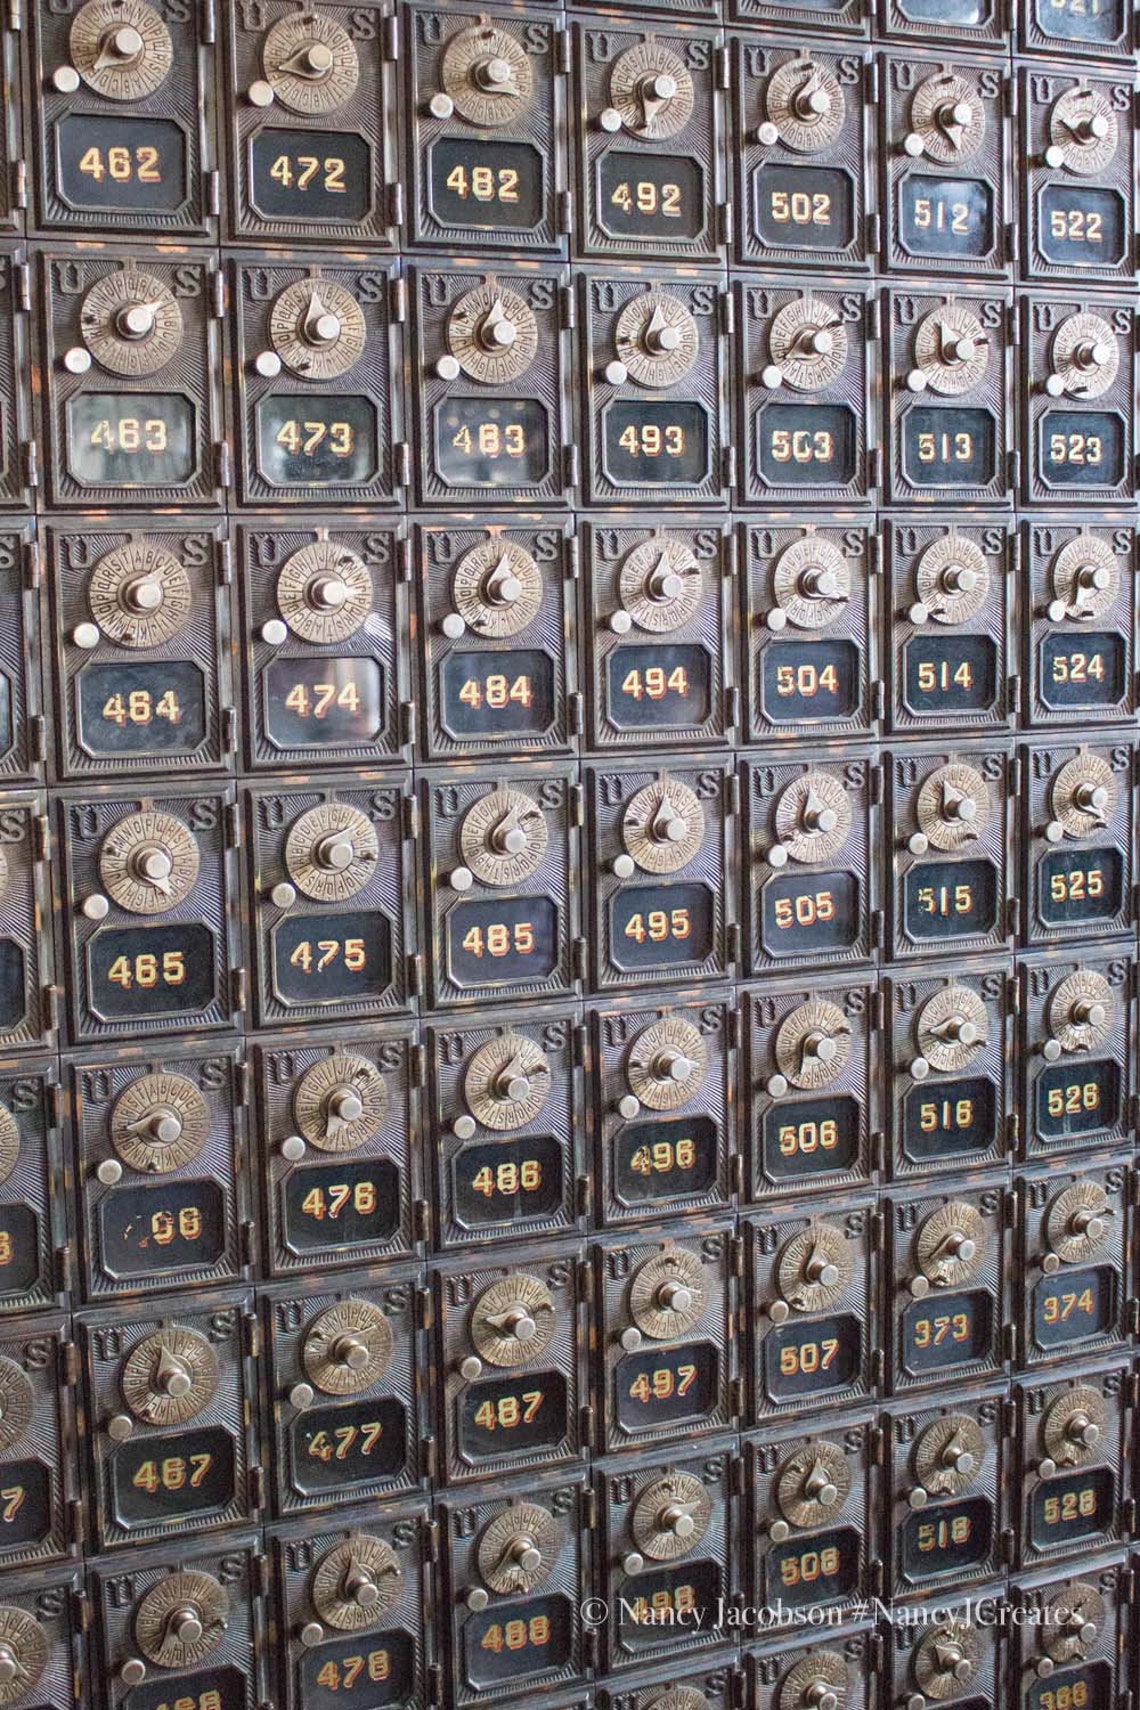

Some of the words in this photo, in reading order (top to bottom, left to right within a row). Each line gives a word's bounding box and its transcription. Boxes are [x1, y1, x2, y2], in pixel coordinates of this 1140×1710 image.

[79, 146, 162, 183] 462
[270, 156, 348, 193] 472
[446, 165, 519, 202] 482
[611, 182, 681, 218] 492
[772, 193, 832, 225] 502
[914, 200, 968, 234] 512
[1051, 211, 1102, 240] 522
[90, 419, 168, 456] 463
[277, 420, 352, 457] 473
[453, 424, 525, 457] 483
[619, 426, 683, 457] 493
[772, 431, 833, 464] 503
[918, 433, 971, 464] 513
[1050, 434, 1101, 464] 523
[622, 666, 689, 699] 494
[776, 665, 837, 696] 504
[918, 661, 972, 691] 514
[1053, 653, 1103, 683] 524
[286, 682, 360, 719] 474
[459, 675, 532, 708] 484
[918, 884, 972, 916] 515
[1051, 870, 1102, 902] 525
[625, 908, 690, 944] 495
[775, 891, 834, 929] 505
[291, 938, 367, 972] 475
[462, 923, 534, 957] 485
[109, 951, 186, 988] 465
[920, 1100, 972, 1132] 516
[1048, 1082, 1100, 1117] 526
[779, 1121, 838, 1157] 506
[630, 1139, 696, 1176] 496
[472, 1160, 543, 1195] 486
[302, 1181, 377, 1219] 476
[1043, 1289, 1095, 1325] 374
[915, 1312, 970, 1349] 373
[780, 1340, 840, 1375] 507
[629, 1366, 698, 1403] 497
[474, 1392, 545, 1429] 487
[308, 1423, 382, 1460] 477
[133, 1453, 212, 1493] 467
[1043, 1490, 1096, 1525] 528
[917, 1516, 970, 1551] 518
[780, 1548, 840, 1585] 508
[481, 1616, 550, 1652] 488
[317, 1650, 390, 1690] 478
